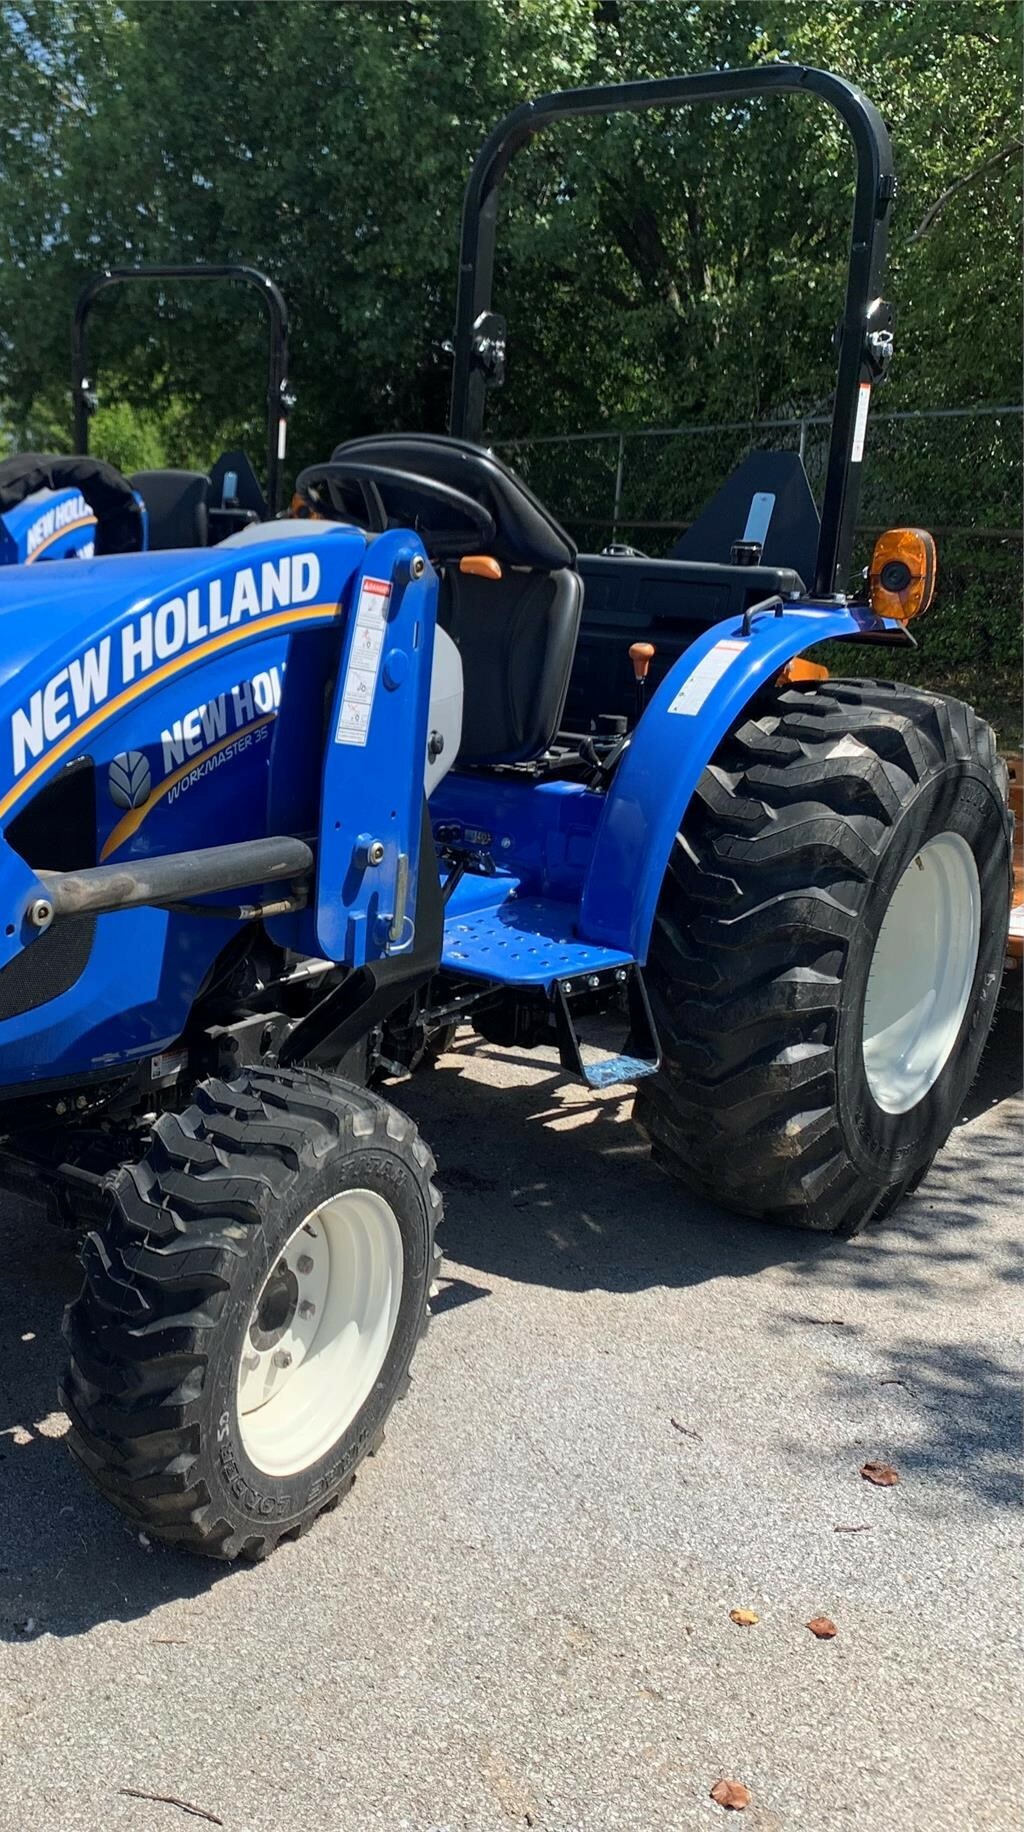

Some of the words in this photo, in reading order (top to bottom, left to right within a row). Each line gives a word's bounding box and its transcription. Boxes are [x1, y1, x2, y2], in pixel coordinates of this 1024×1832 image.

[11, 636, 111, 776] NEW
[121, 552, 321, 684] HOLLAND
[160, 693, 226, 774] NEW
[167, 735, 253, 804] WORKMASTER
[254, 725, 269, 742] 35
